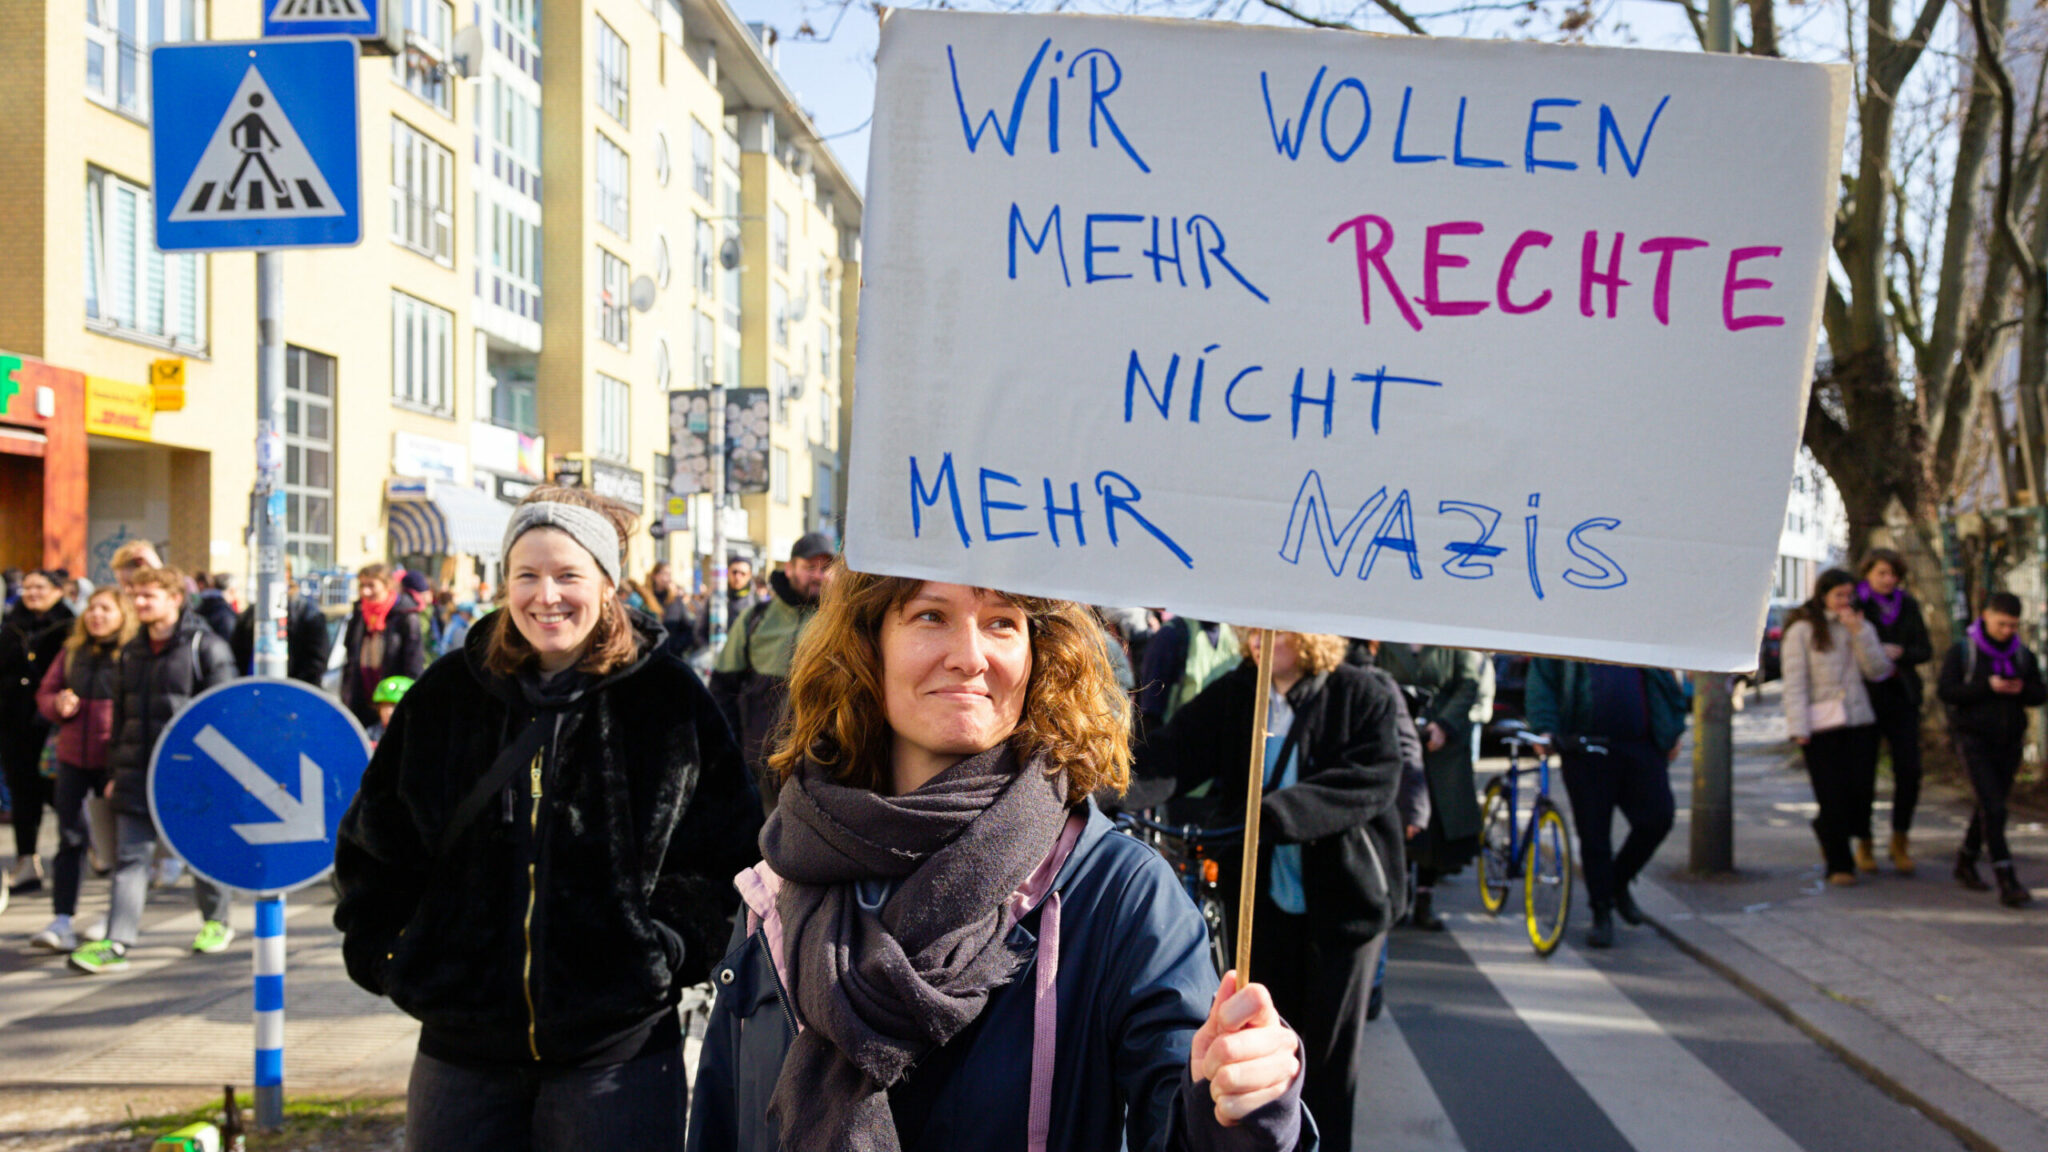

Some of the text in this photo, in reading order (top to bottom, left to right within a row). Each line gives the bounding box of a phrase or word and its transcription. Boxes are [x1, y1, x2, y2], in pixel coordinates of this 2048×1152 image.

[1260, 65, 1670, 177] WOLLEN
[1008, 203, 1785, 331] MEHR RECHTE
[910, 452, 1194, 569] MEHR
